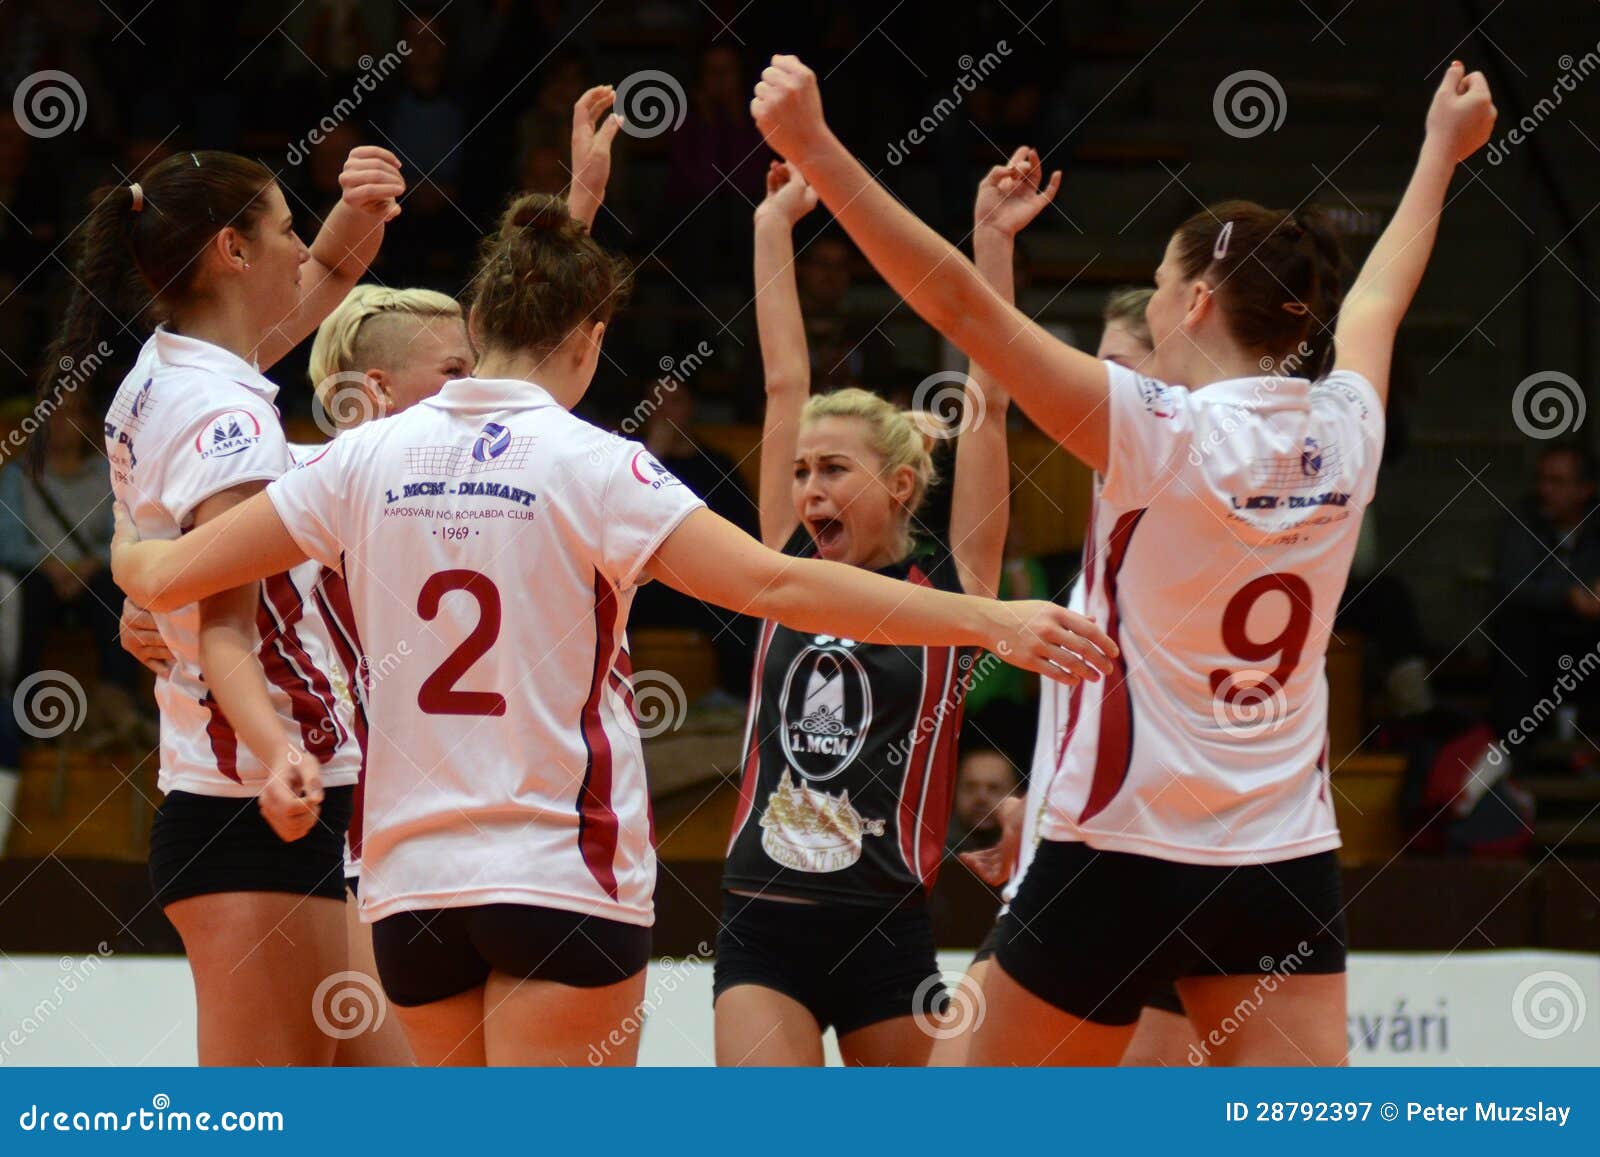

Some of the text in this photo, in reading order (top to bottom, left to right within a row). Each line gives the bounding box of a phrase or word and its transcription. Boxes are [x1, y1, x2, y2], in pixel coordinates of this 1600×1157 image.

[201, 436, 261, 460] DIAMANT
[403, 482, 446, 498] MCM
[458, 482, 536, 507] DIAMANT
[507, 509, 535, 521] CLUB
[441, 526, 469, 540] 1969
[416, 569, 507, 717] 2
[1209, 572, 1313, 707] 9
[791, 734, 849, 757] 1. MCM
